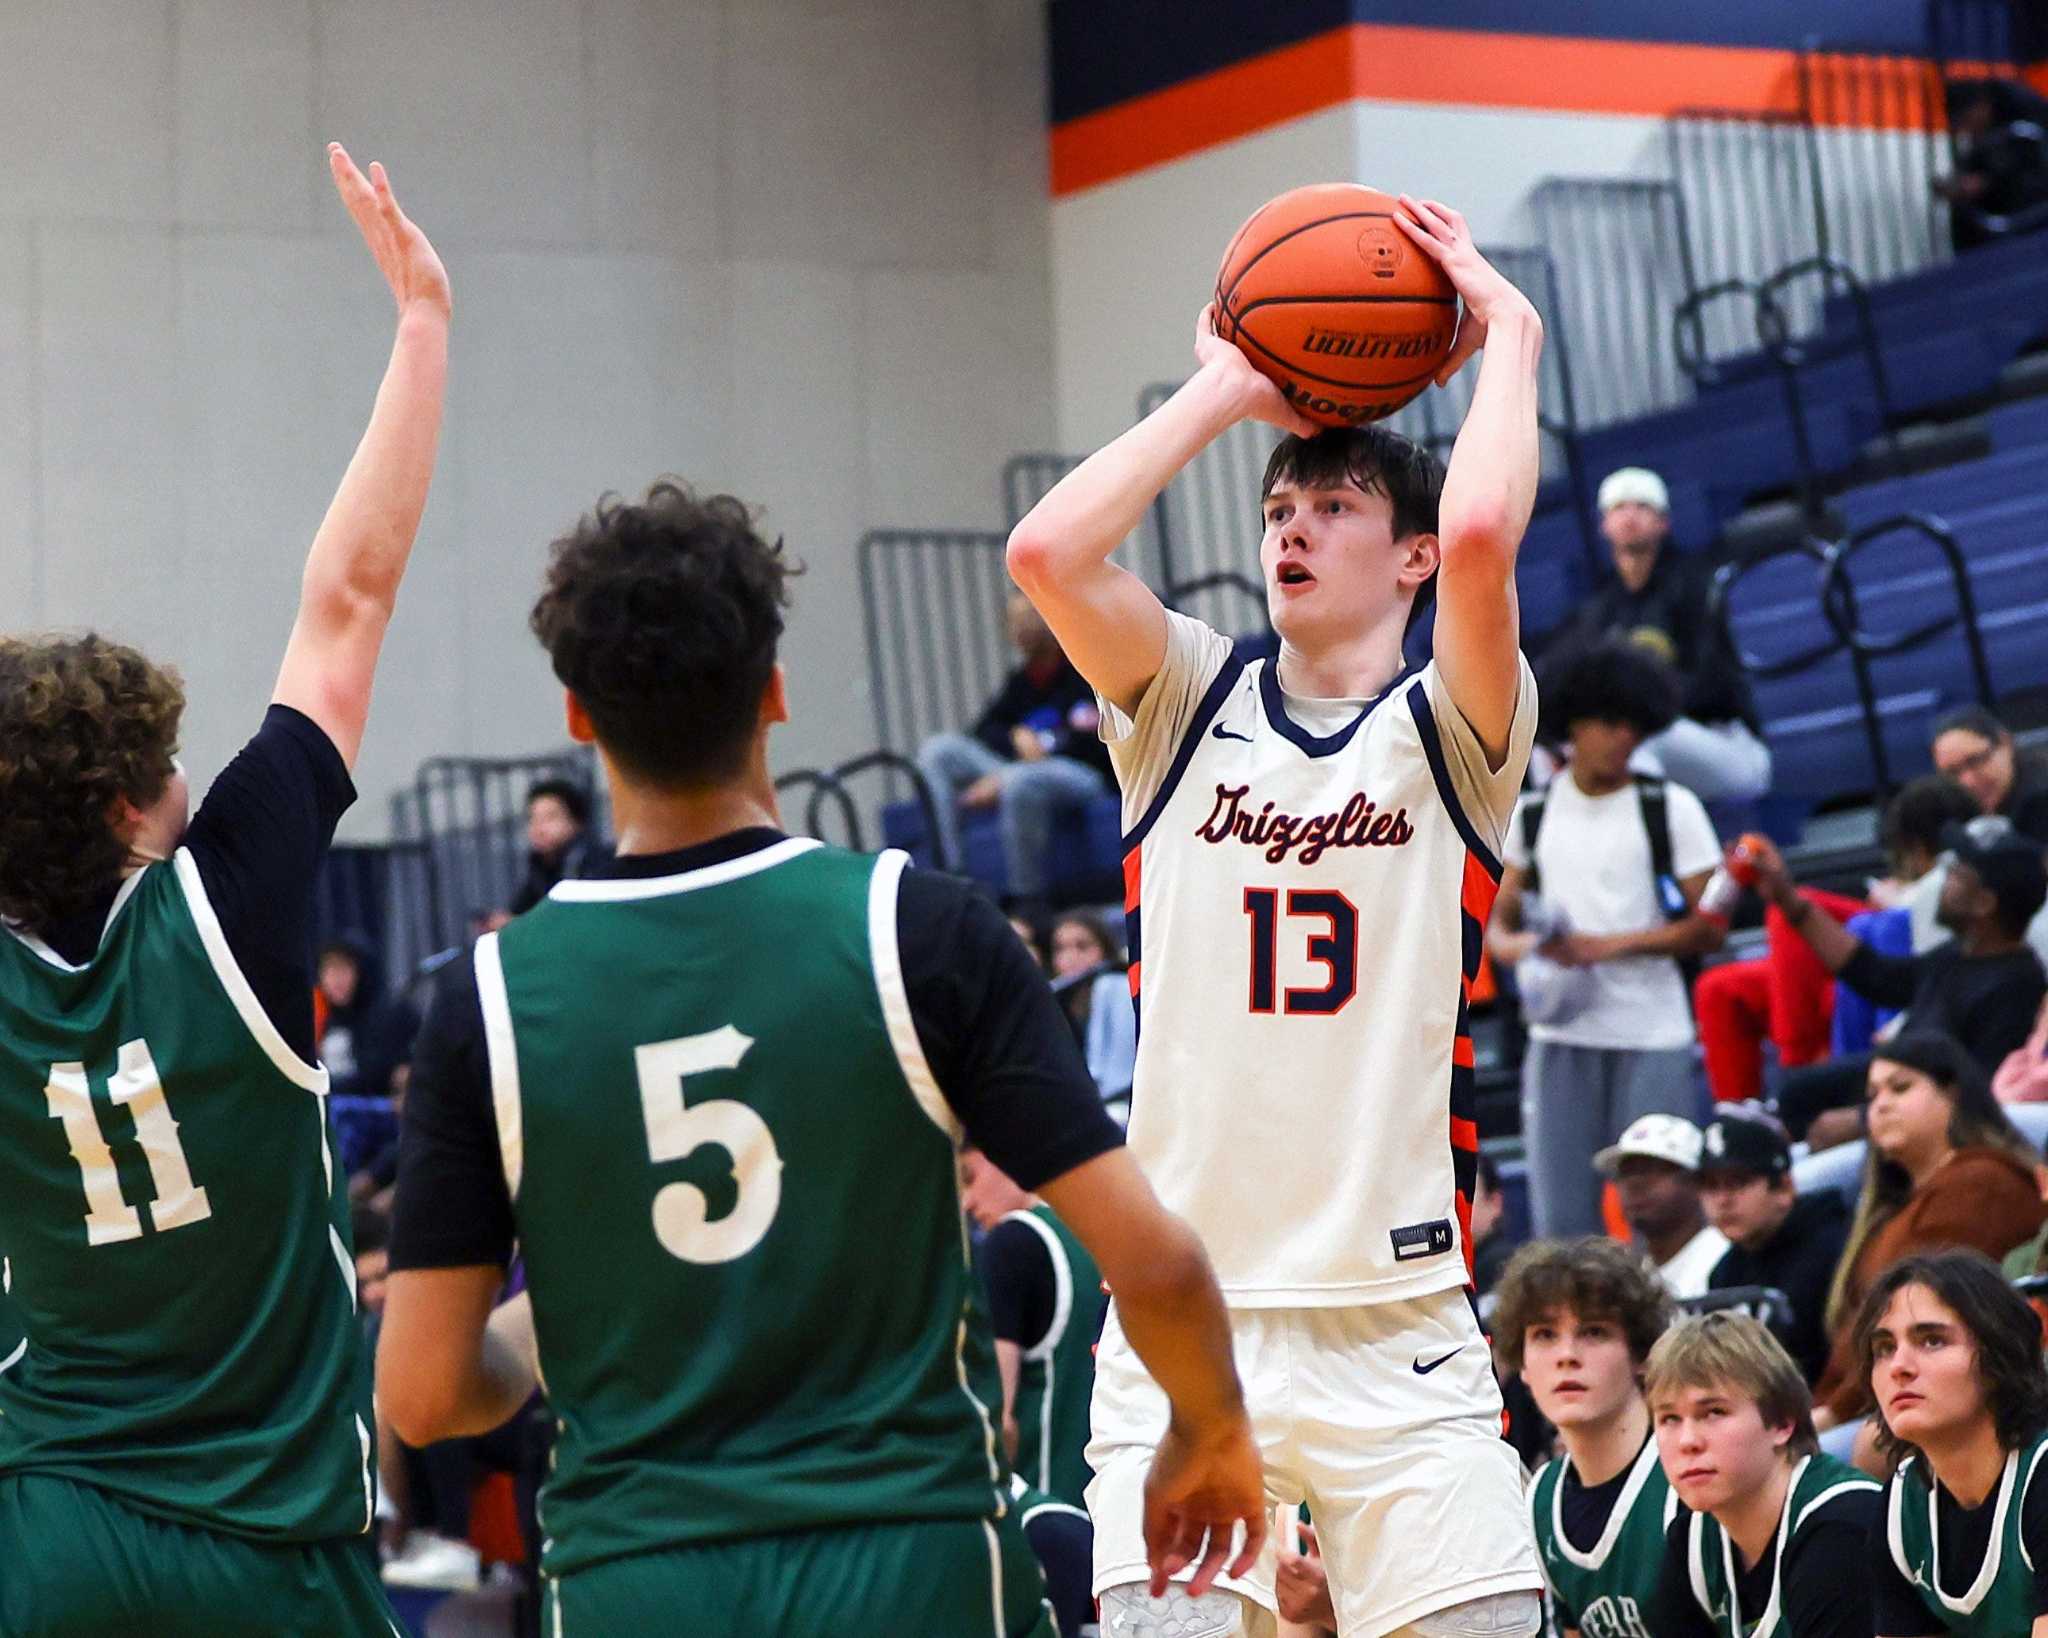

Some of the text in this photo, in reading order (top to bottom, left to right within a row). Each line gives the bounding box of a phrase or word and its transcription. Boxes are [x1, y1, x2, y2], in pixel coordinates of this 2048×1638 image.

[1195, 783, 1414, 865] Grizzlies
[1243, 886, 1359, 1015] 13
[43, 1037, 212, 1247] 11
[633, 1024, 785, 1265] 5
[1435, 1229, 1446, 1244] M
